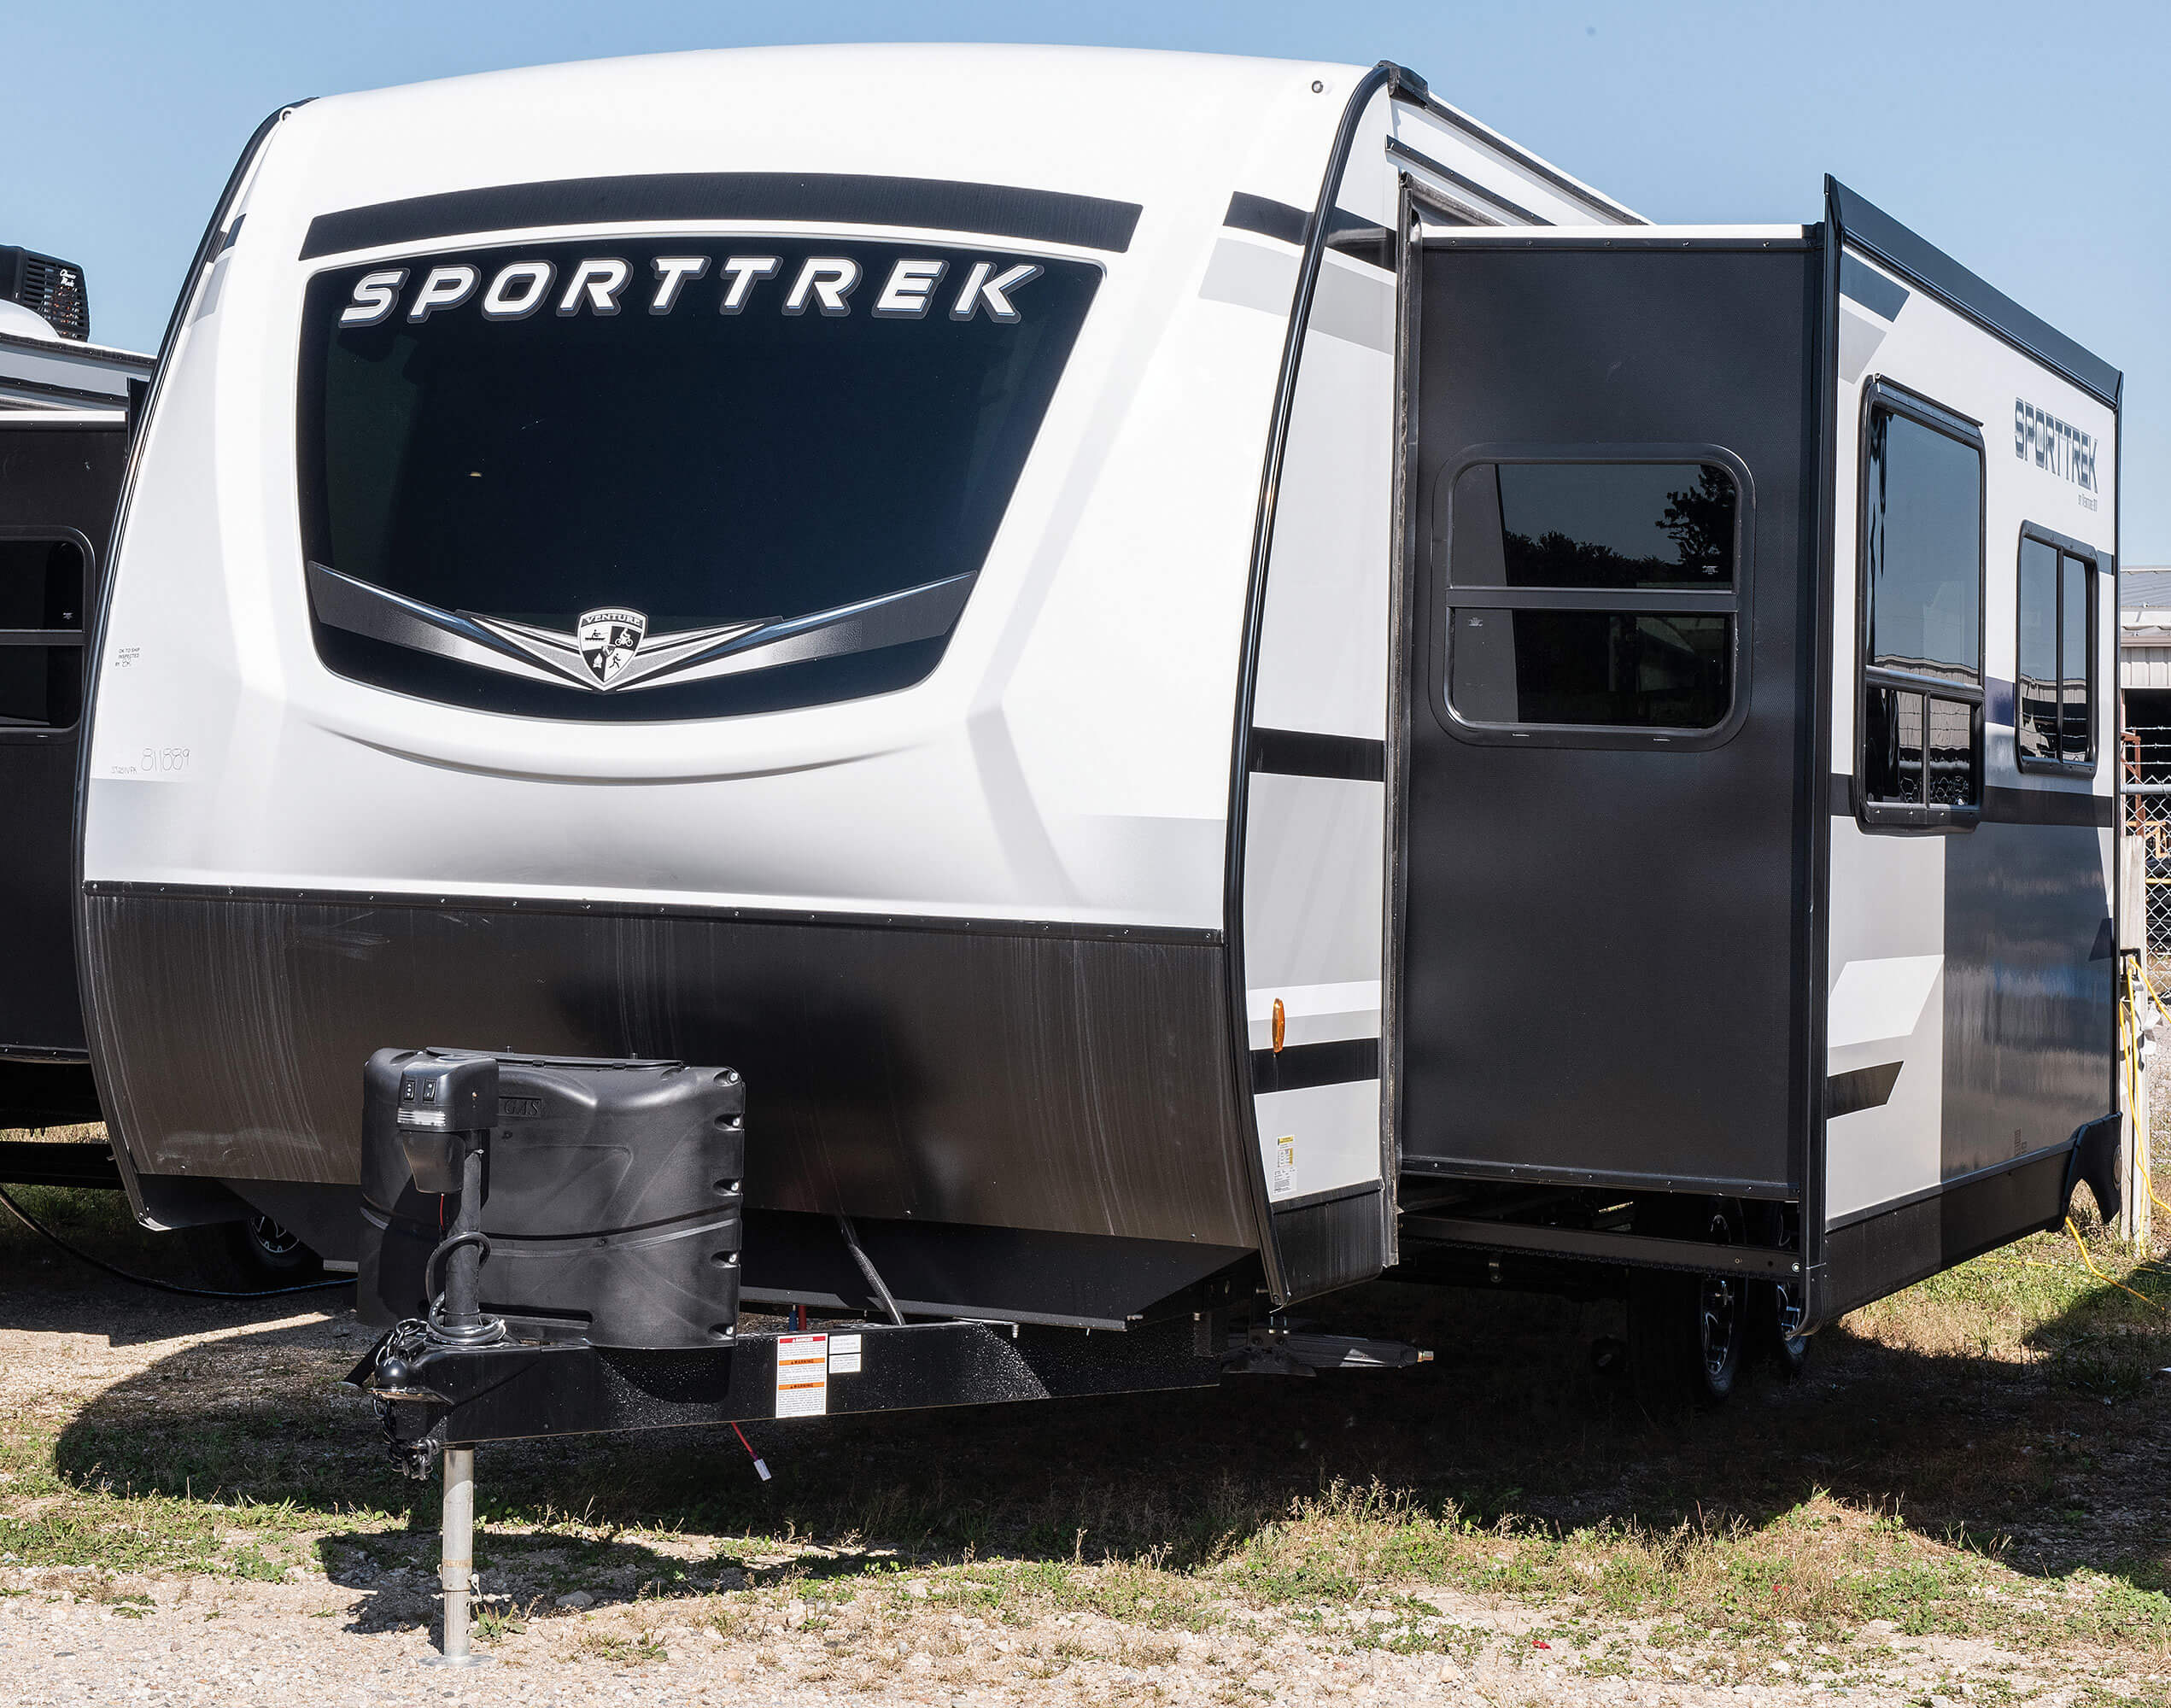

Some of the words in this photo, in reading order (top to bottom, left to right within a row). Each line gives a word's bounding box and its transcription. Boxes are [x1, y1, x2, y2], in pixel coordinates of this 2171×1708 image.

[340, 256, 1039, 322] SPORTTREK
[2015, 397, 2098, 494] SPORTTREK
[586, 614, 641, 624] VENTURE
[141, 748, 190, 772] 811889
